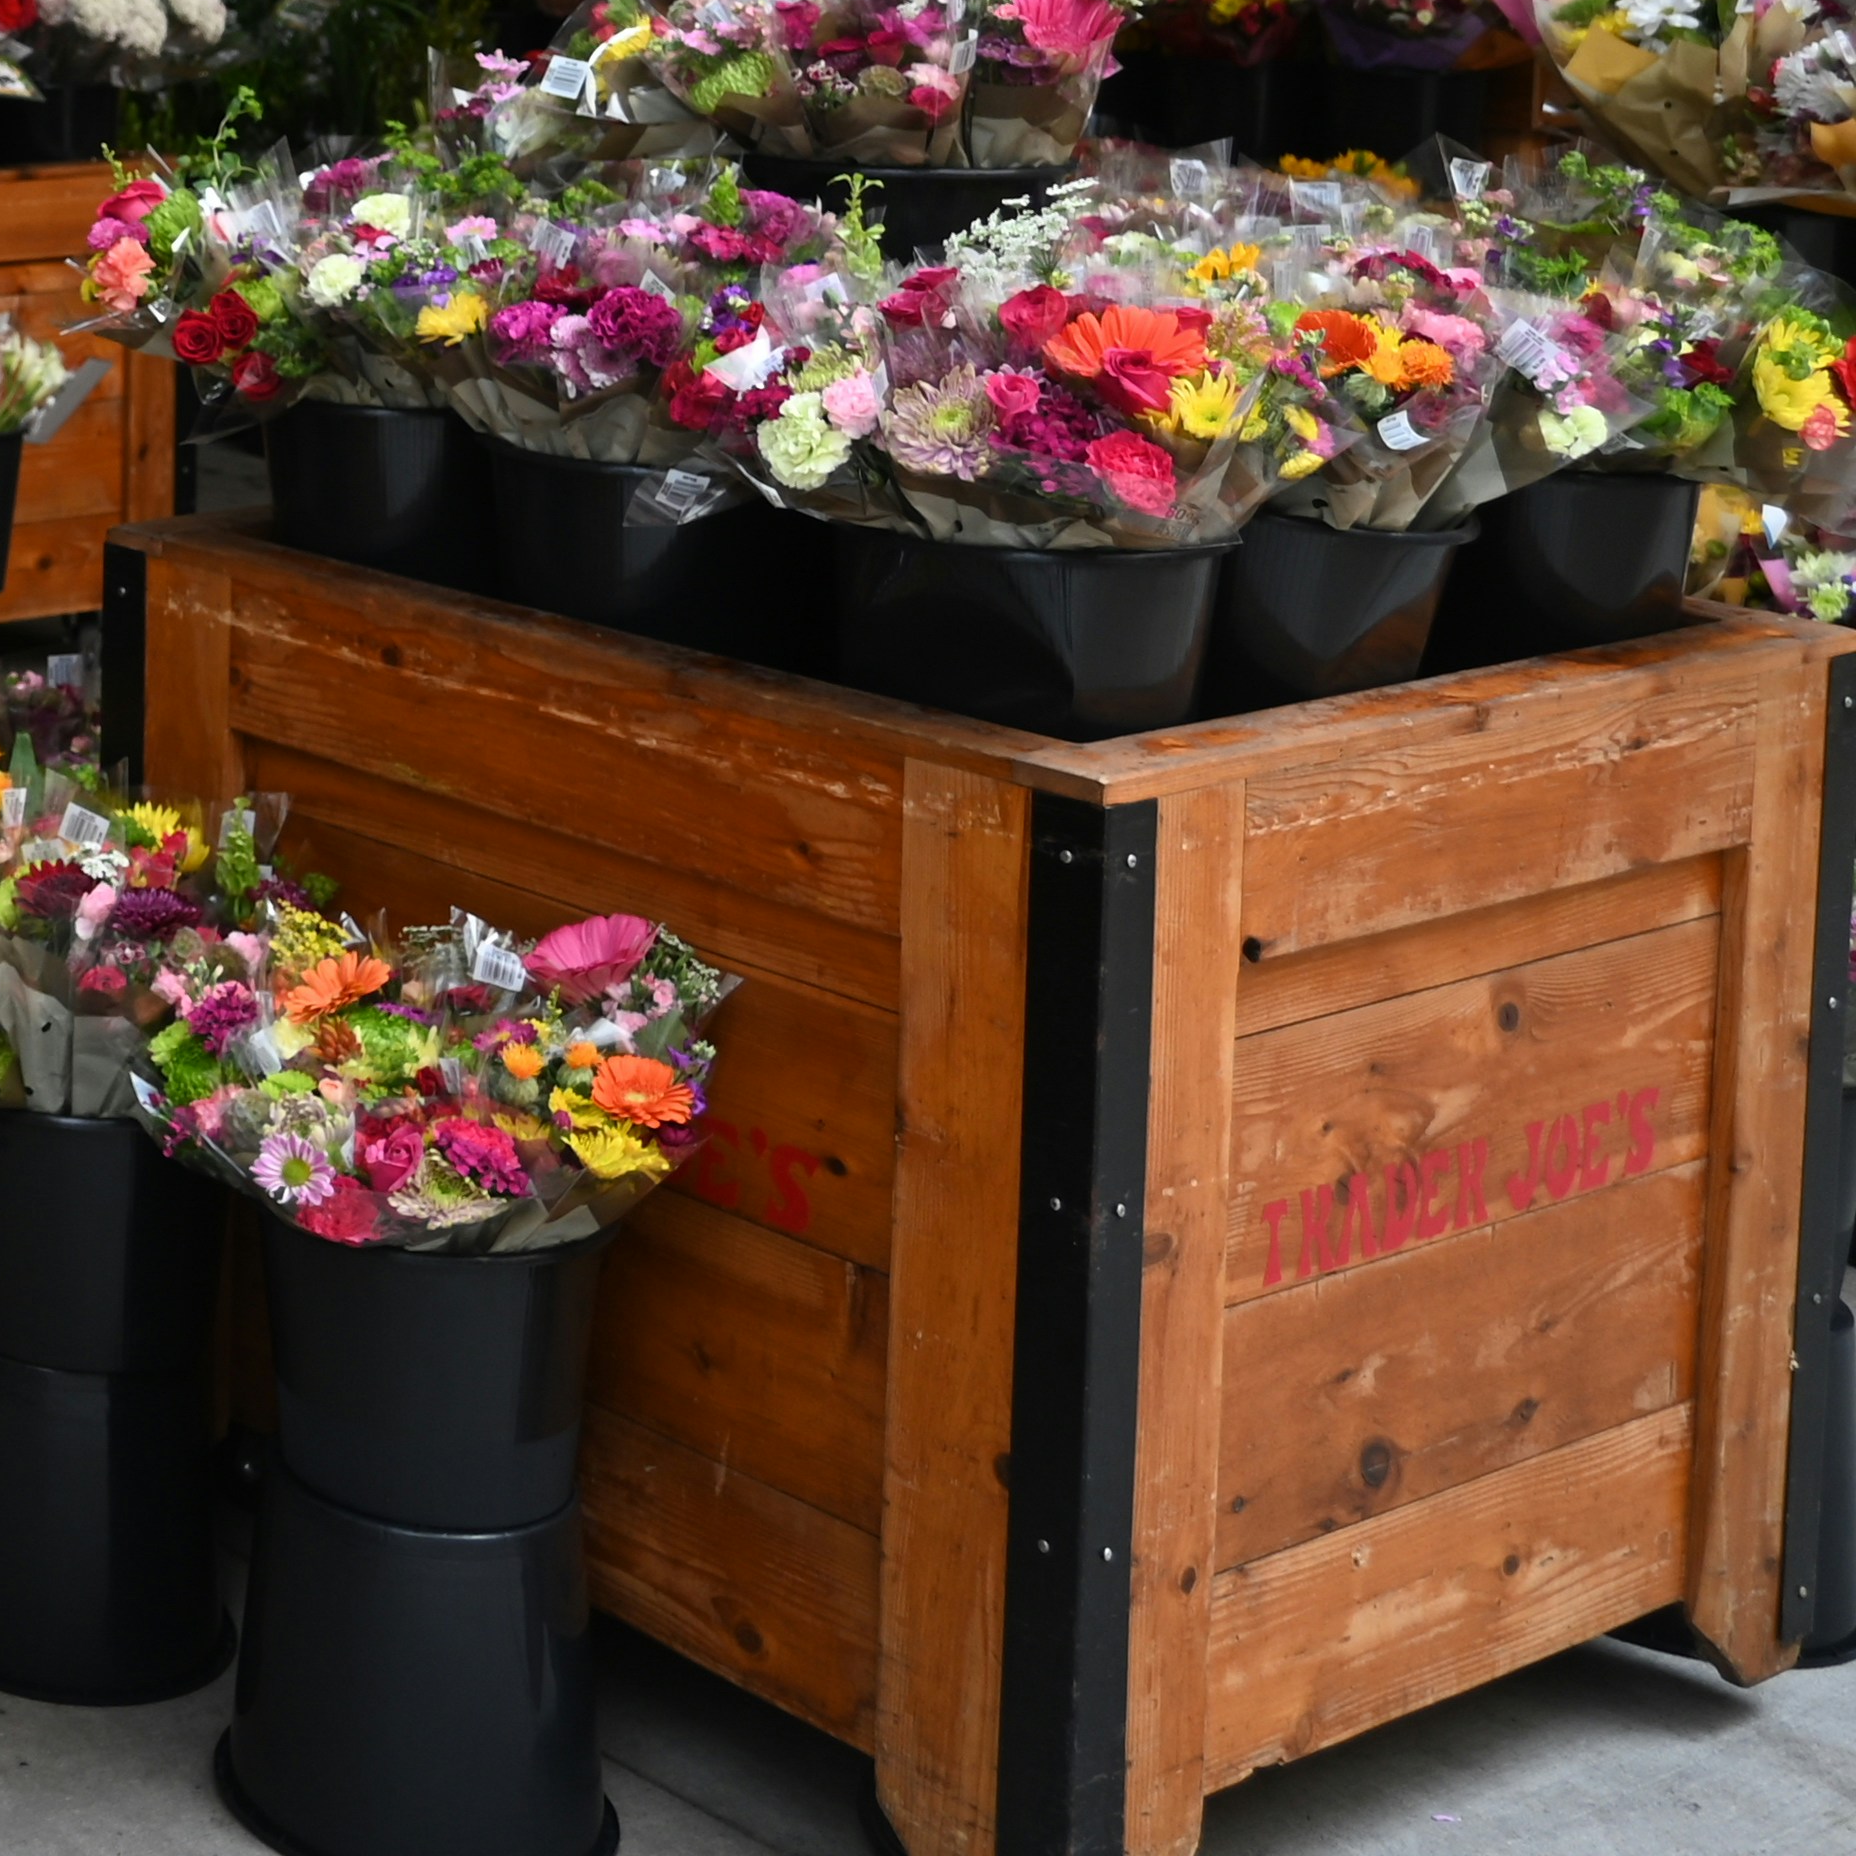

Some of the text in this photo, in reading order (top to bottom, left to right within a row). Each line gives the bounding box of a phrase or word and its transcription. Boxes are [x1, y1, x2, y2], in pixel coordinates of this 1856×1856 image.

[688, 1117, 822, 1233] E'S
[1261, 1087, 1662, 1288] TRADER JOE'S
